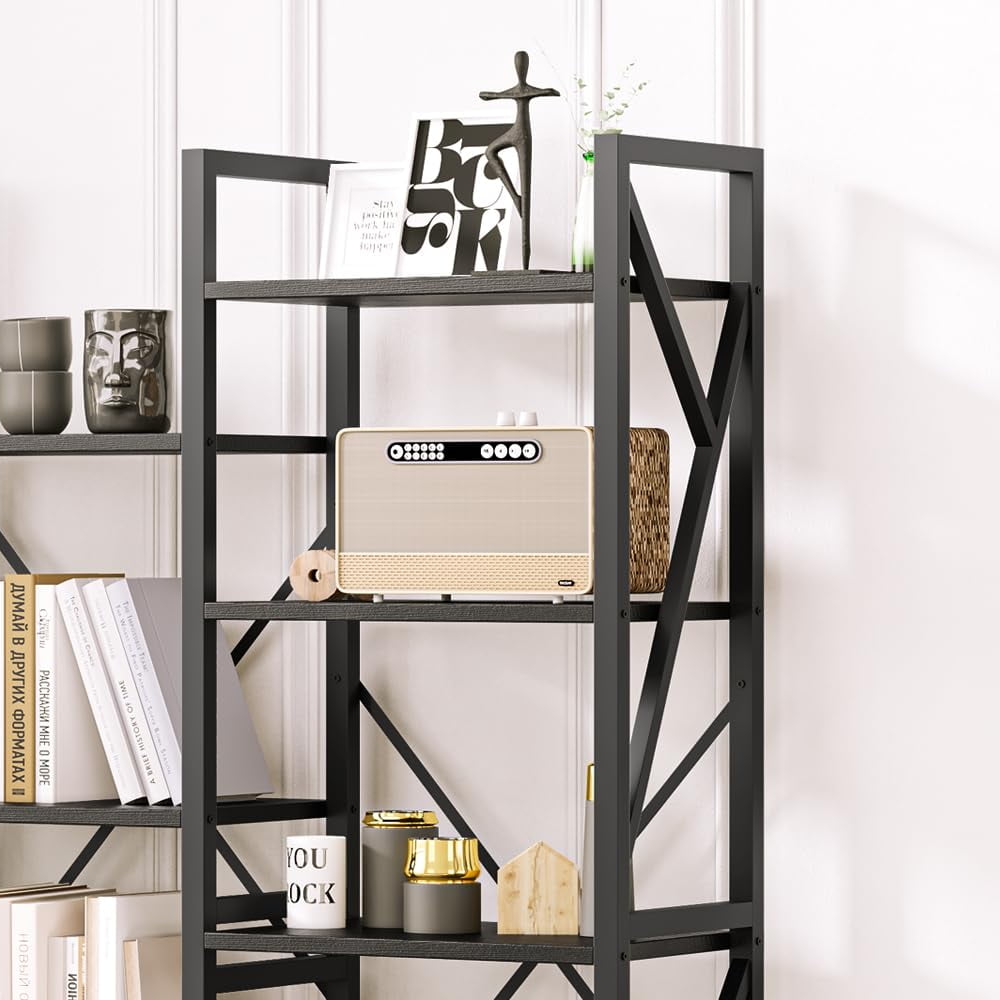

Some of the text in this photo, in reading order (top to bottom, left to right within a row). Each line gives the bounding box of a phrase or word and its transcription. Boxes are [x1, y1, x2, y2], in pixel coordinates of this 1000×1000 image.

[10, 583, 28, 632] ДУМАЙ
[12, 637, 24, 646] В
[10, 650, 25, 704] ДРУГИХ
[39, 670, 51, 722] РАССКАЖИ
[12, 709, 25, 783] ФОРМАТАХ
[39, 725, 50, 747] МНЕ
[39, 759, 50, 786] МОРЕ
[287, 847, 328, 869] YOU
[288, 882, 336, 904] OCK
[18, 933, 31, 987] НОВЫЙ
